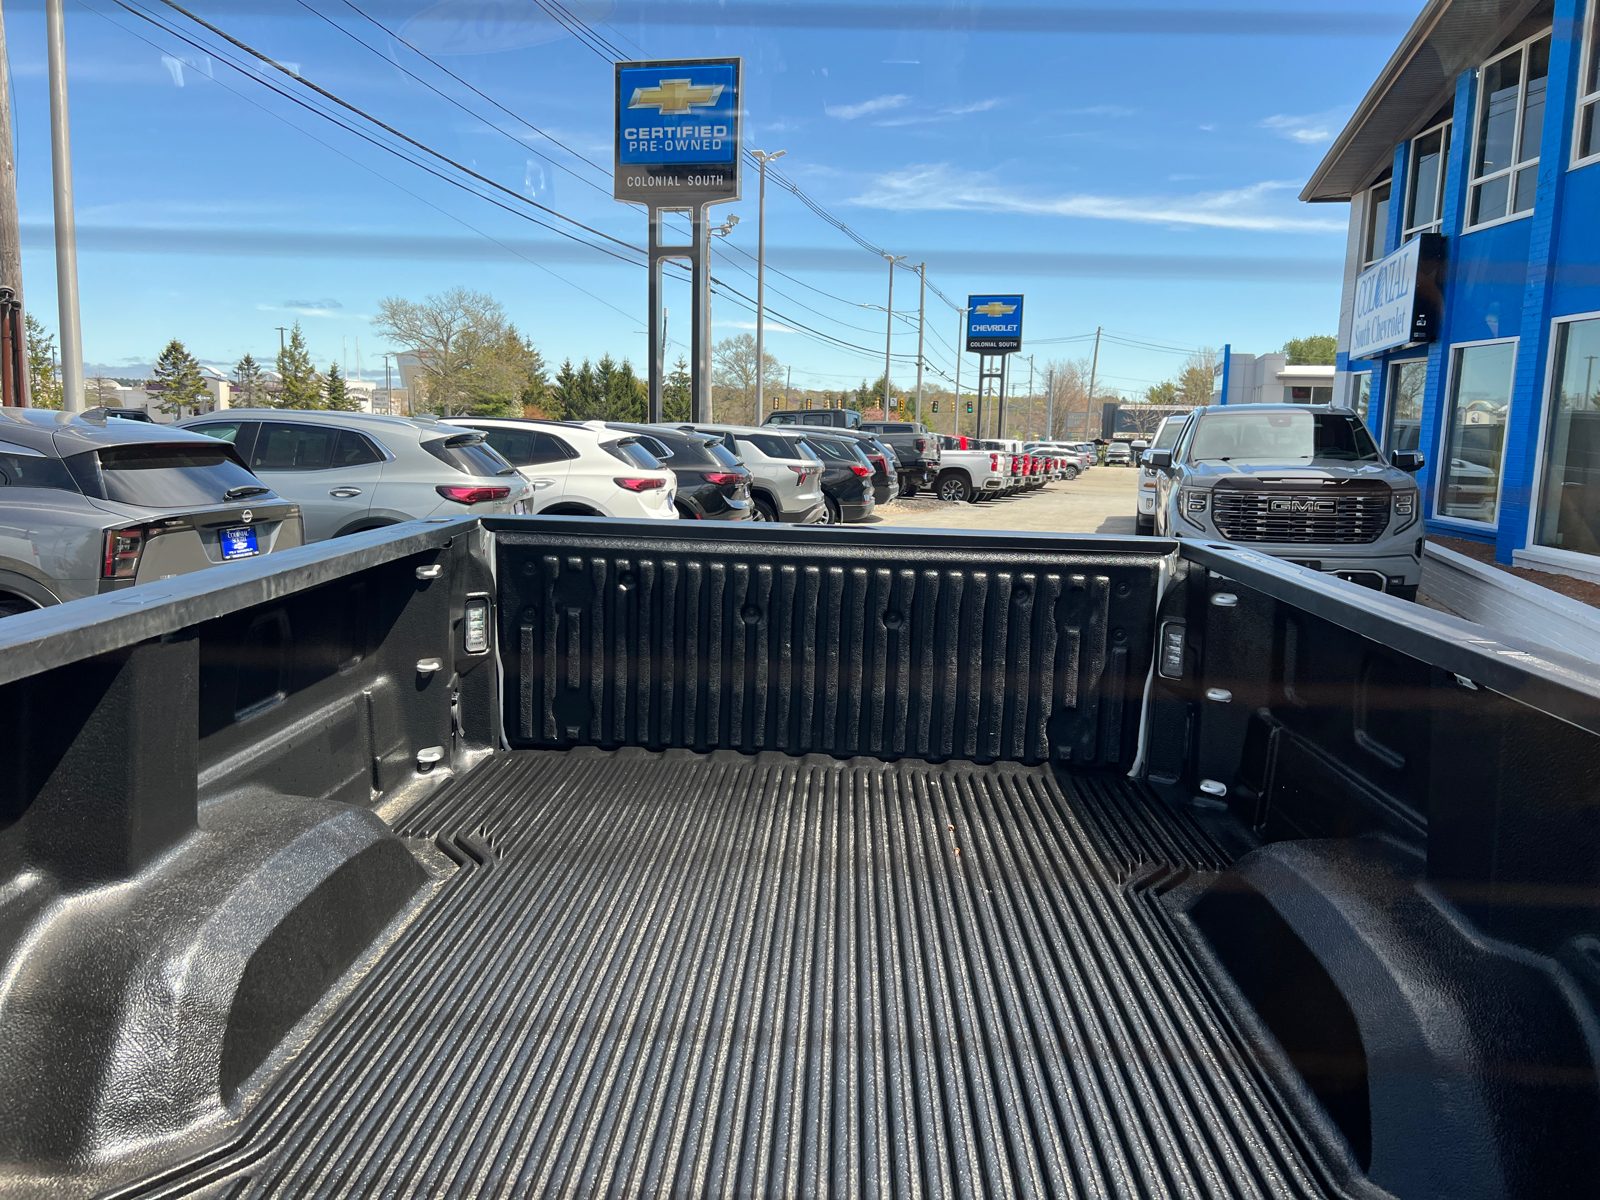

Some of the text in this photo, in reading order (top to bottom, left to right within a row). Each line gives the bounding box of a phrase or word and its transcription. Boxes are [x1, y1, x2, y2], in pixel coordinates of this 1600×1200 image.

[624, 125, 727, 140] CERTIFIED
[629, 139, 722, 152] PRE-OWNED
[627, 175, 723, 187] COLONIAL SOUTH
[1357, 252, 1409, 319] COLONIAL
[971, 324, 1018, 332] CHEVROLET
[1354, 306, 1406, 350] South Chevrolet
[1270, 500, 1335, 514] GMC
